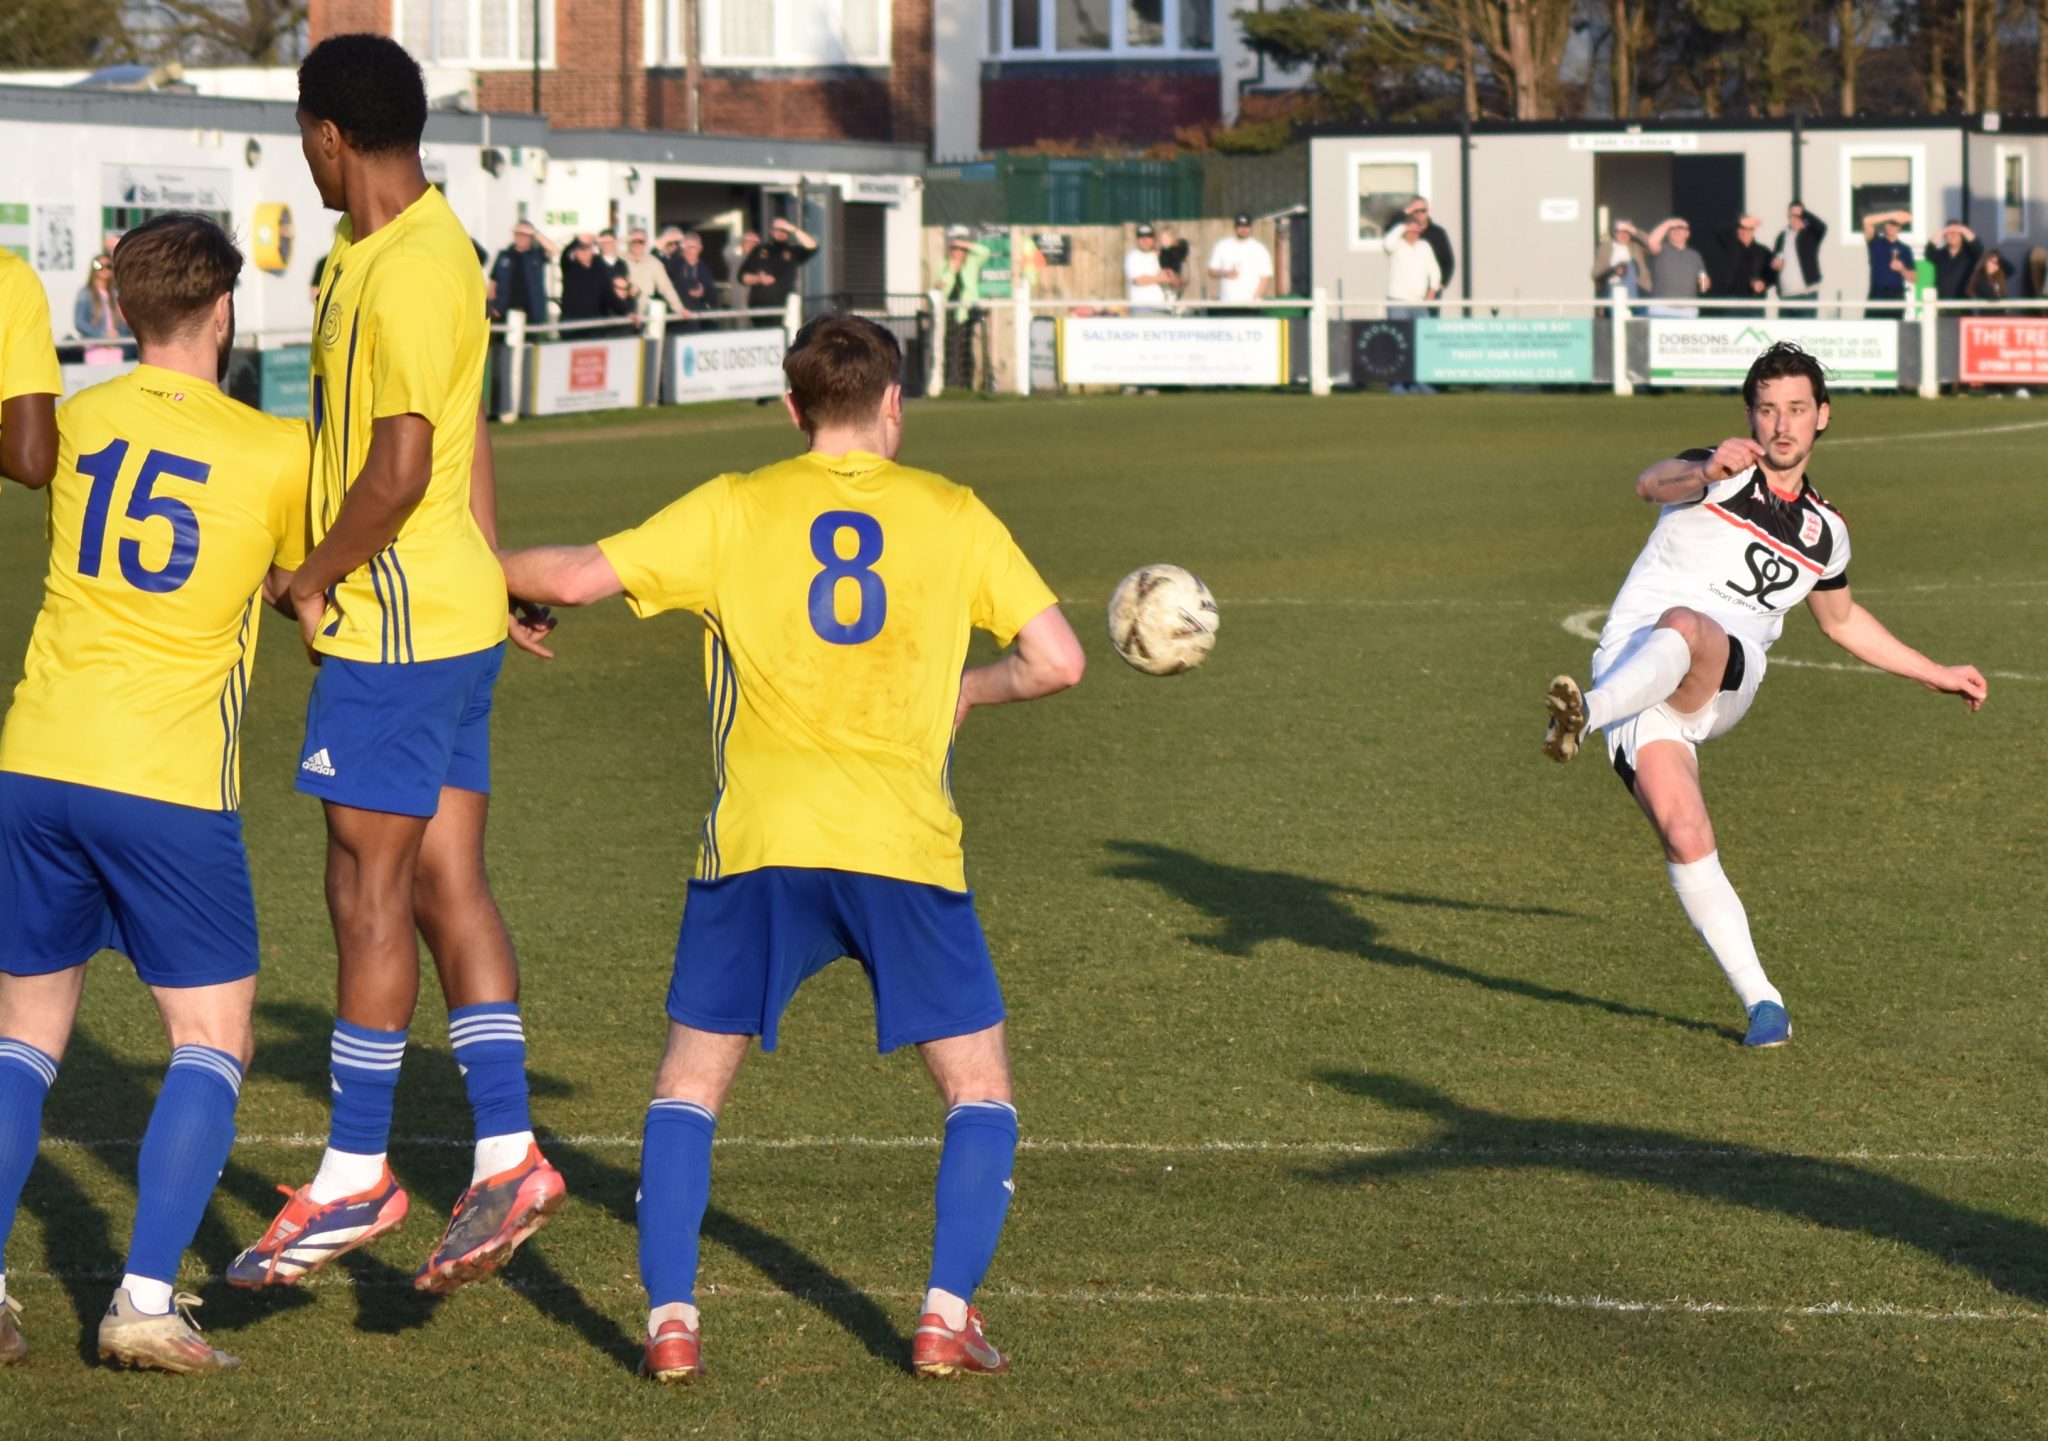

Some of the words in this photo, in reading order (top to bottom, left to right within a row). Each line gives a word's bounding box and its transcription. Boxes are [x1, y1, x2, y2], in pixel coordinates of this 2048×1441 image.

[1082, 330, 1139, 342] SALTASH
[1144, 330, 1233, 342] ENTERPRISES
[1237, 330, 1262, 342] LTD
[1659, 334, 1729, 345] DOBSONS
[1800, 335, 1843, 346] Contact
[1847, 337, 1858, 346] us
[1973, 327, 2007, 346] THE
[697, 349, 719, 372] CSG
[722, 345, 780, 369] LOGISTICS
[1658, 346, 1706, 354] BUILDING
[76, 438, 212, 594] 15
[808, 510, 887, 646] 8
[1707, 583, 1732, 602] Smart
[302, 761, 336, 777] adidas
